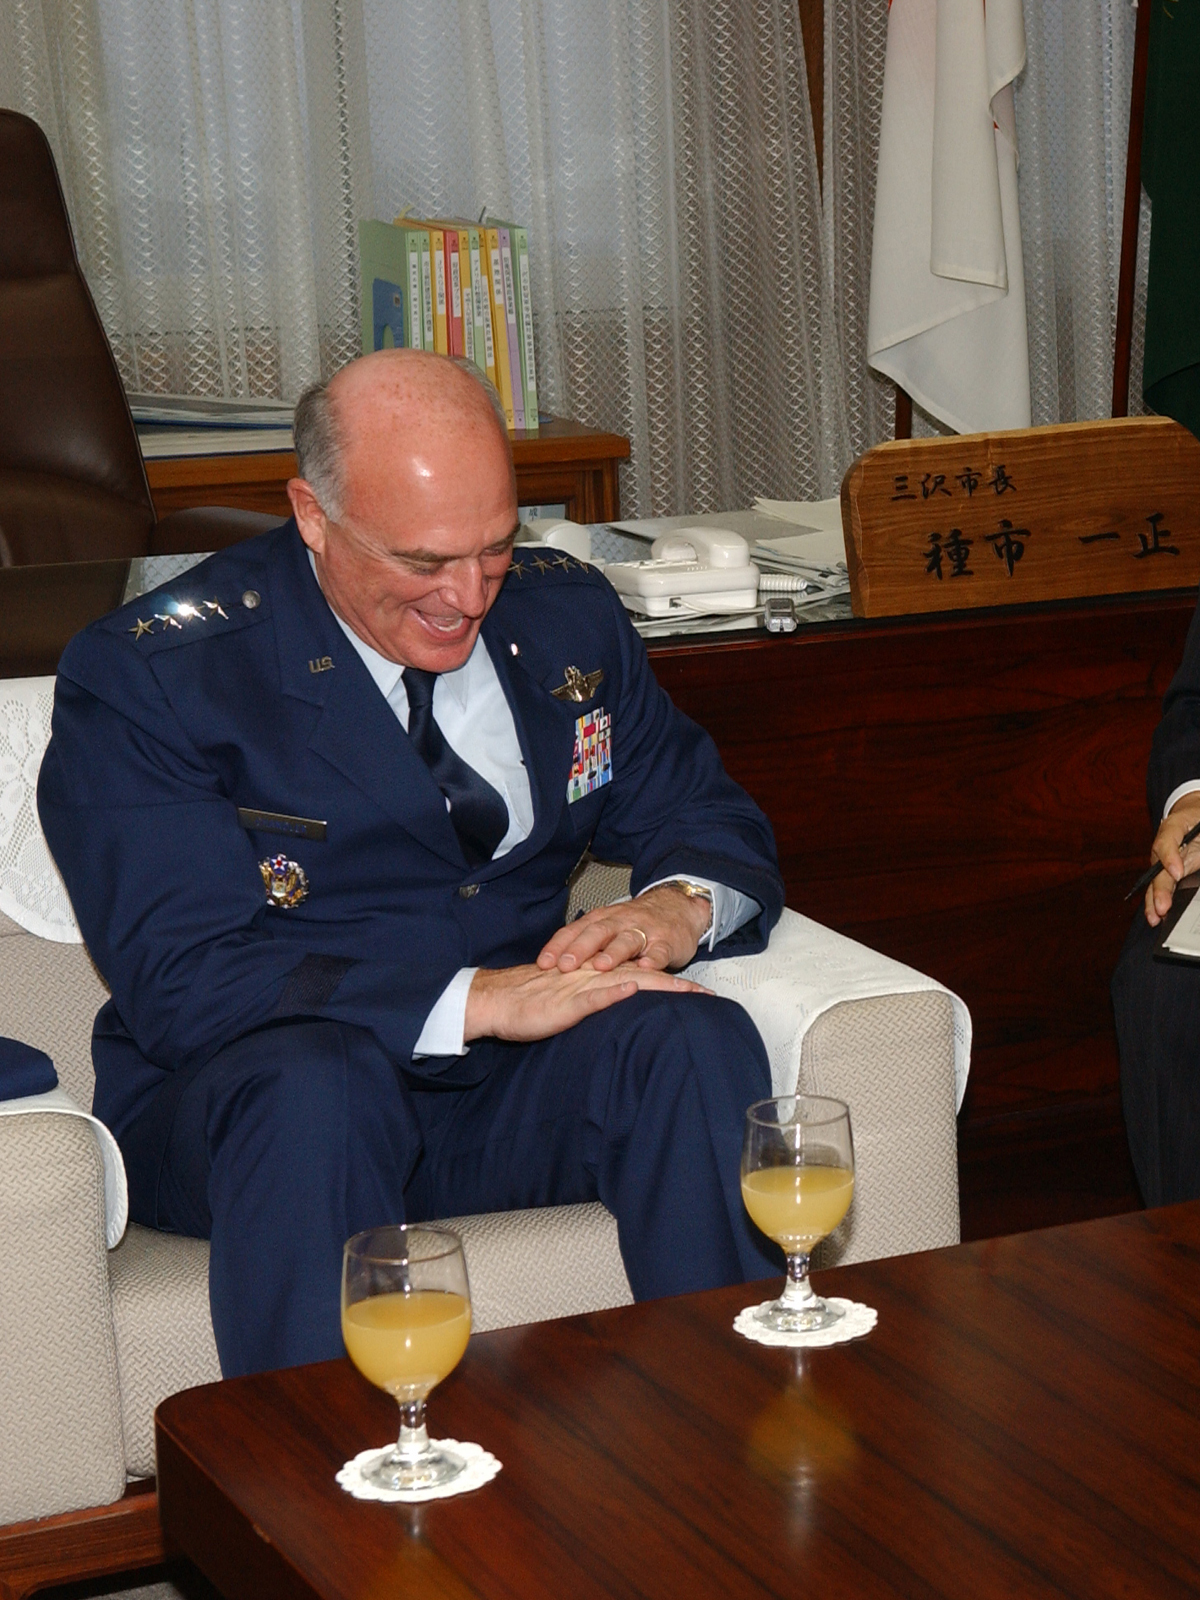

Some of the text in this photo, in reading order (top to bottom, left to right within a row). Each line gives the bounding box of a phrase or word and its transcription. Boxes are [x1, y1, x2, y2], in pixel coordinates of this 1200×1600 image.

[891, 464, 1018, 501] 三沢市長
[922, 512, 1181, 581] 種市 一正
